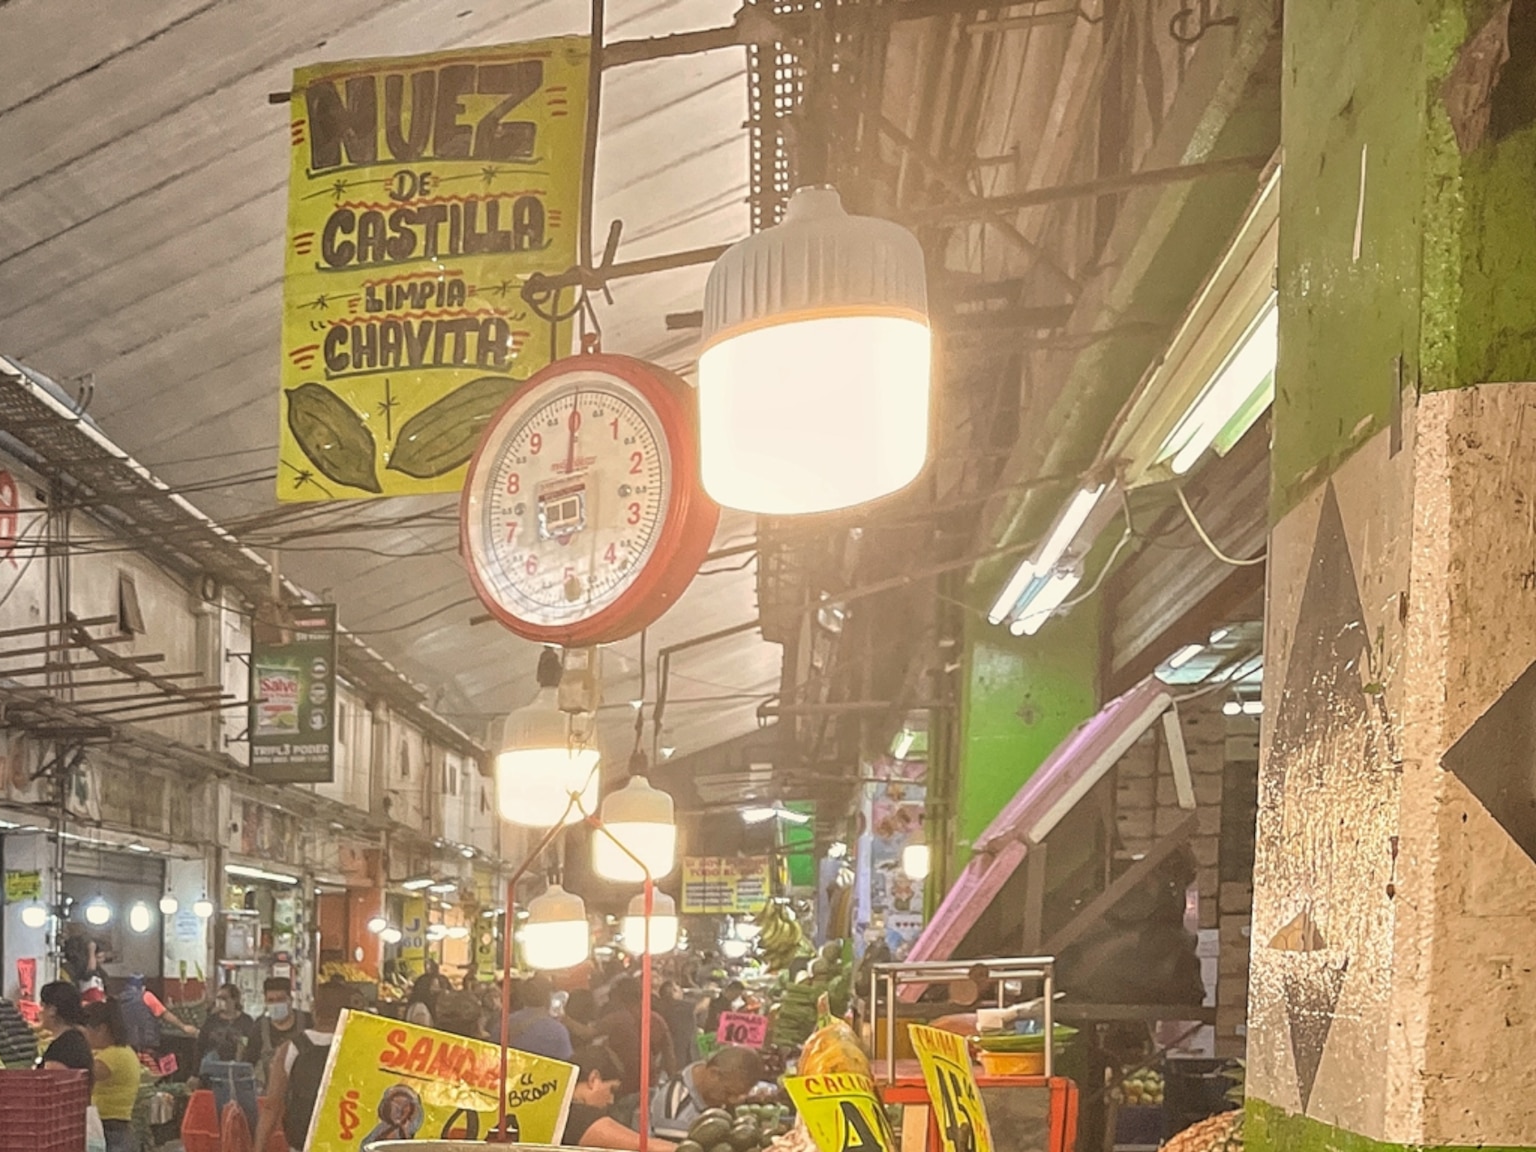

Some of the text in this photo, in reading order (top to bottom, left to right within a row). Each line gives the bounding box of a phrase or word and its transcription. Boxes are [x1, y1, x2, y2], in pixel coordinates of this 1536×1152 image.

[306, 60, 543, 169] NUEZ
[389, 169, 432, 201] DE
[322, 196, 545, 266] CASTILLA
[364, 279, 465, 313] LIMPIA
[610, 419, 619, 440] 1
[530, 433, 542, 455] 9
[630, 452, 643, 475] 2
[506, 473, 519, 495] 8
[627, 502, 640, 525] 3
[505, 522, 517, 543] 7
